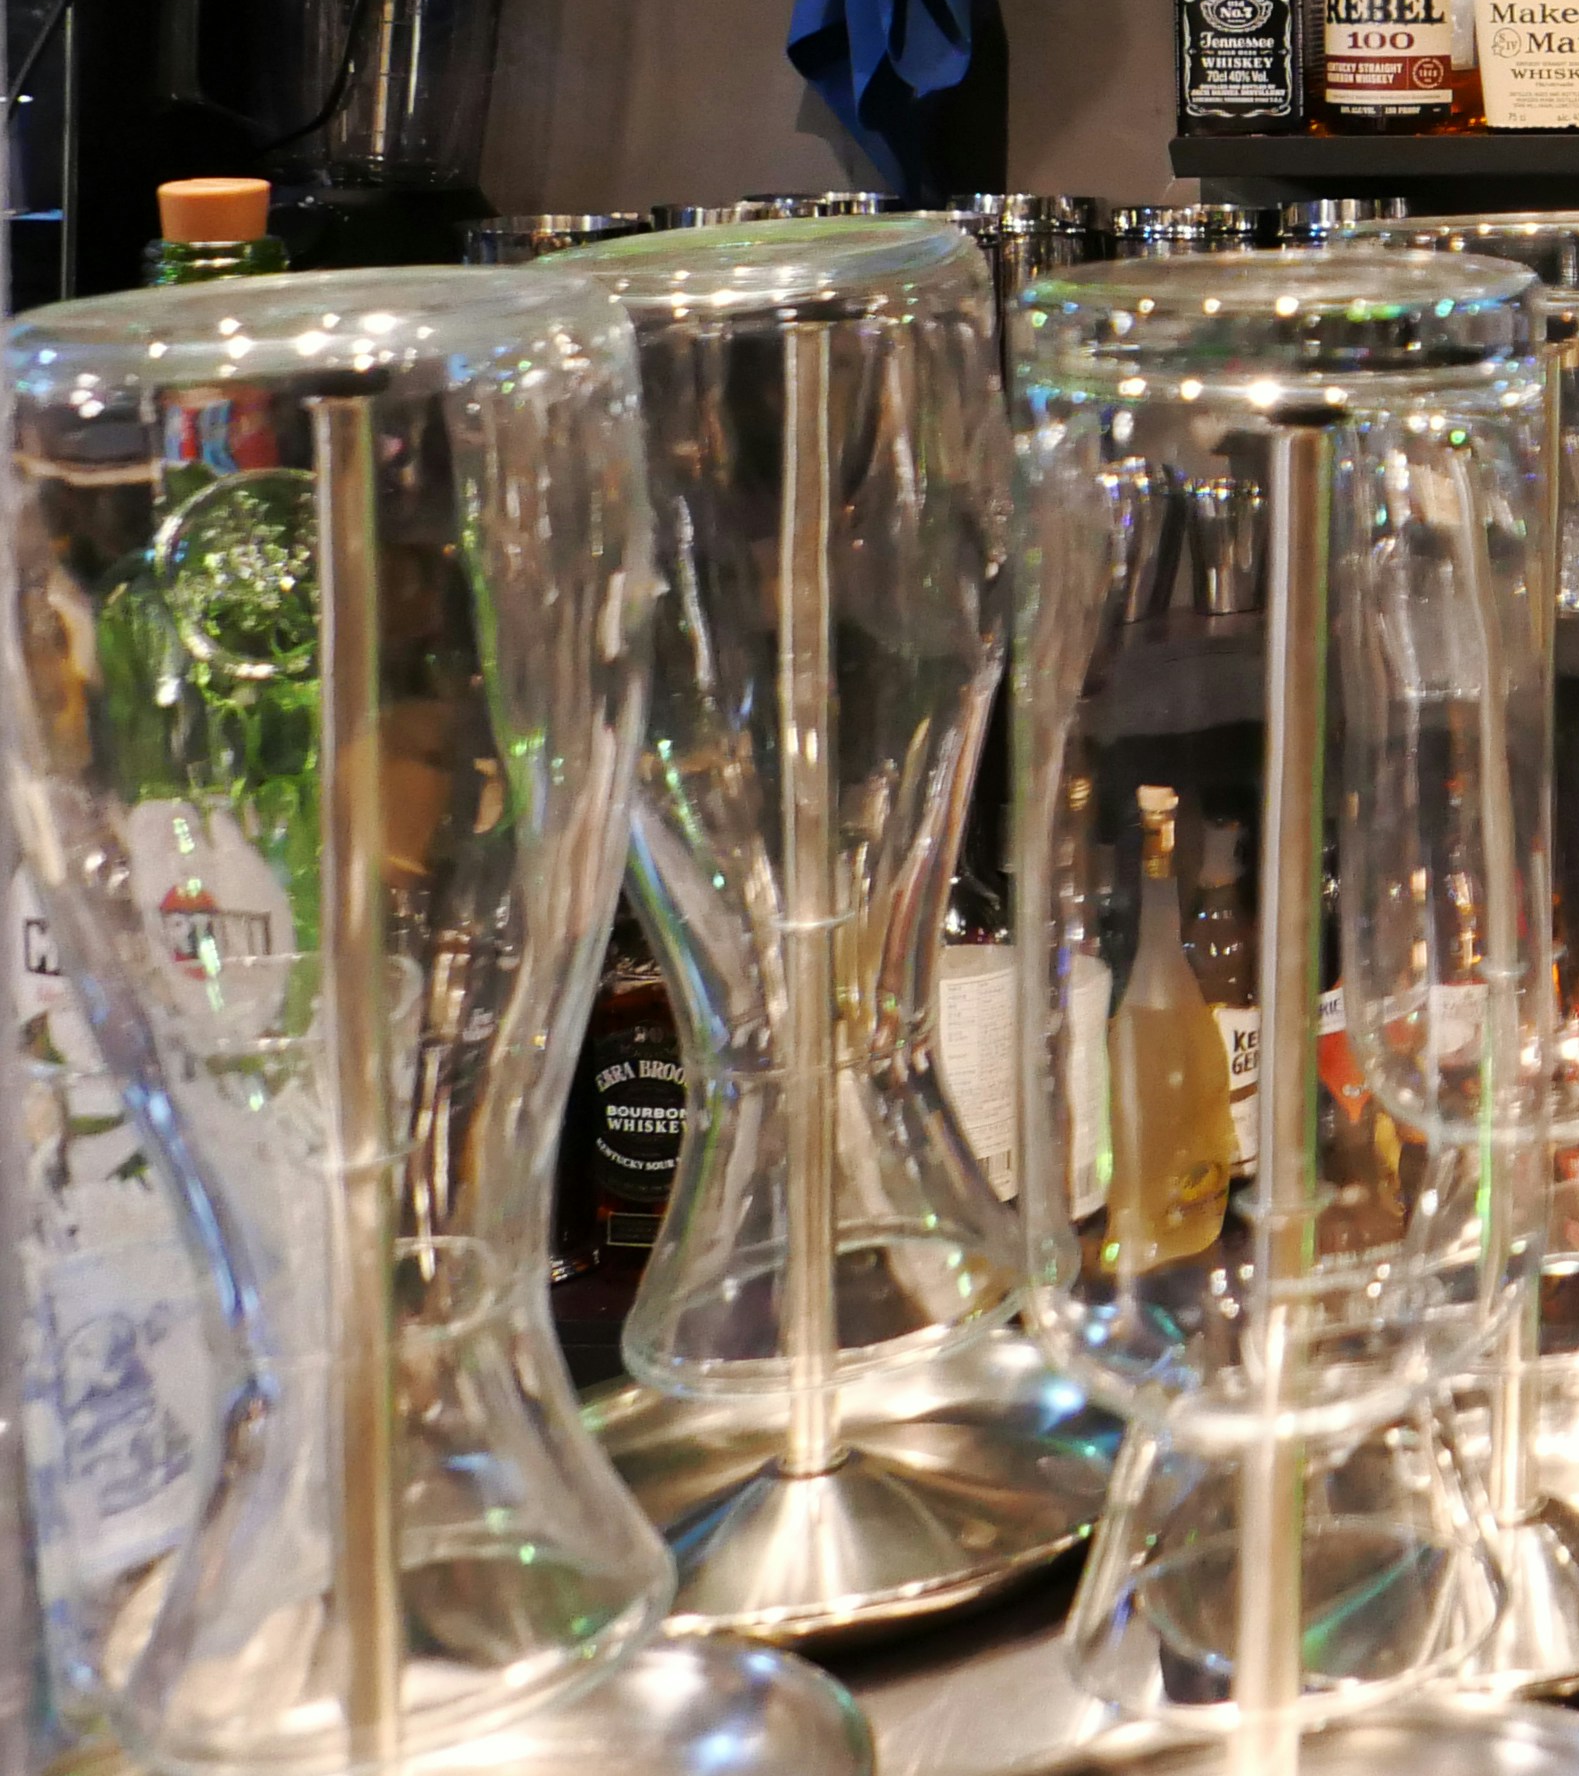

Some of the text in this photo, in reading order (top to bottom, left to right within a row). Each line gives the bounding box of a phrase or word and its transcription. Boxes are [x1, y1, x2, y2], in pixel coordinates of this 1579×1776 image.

[1219, 6, 1253, 20] No.7
[1200, 31, 1275, 49] Tennessee
[1347, 31, 1415, 50] 100
[1201, 57, 1274, 70] WHISKEY
[1358, 62, 1404, 74] STRAIGHT
[1229, 70, 1250, 83] 40%
[1355, 73, 1394, 85] WHISKEY
[606, 1105, 688, 1119] BOURBON
